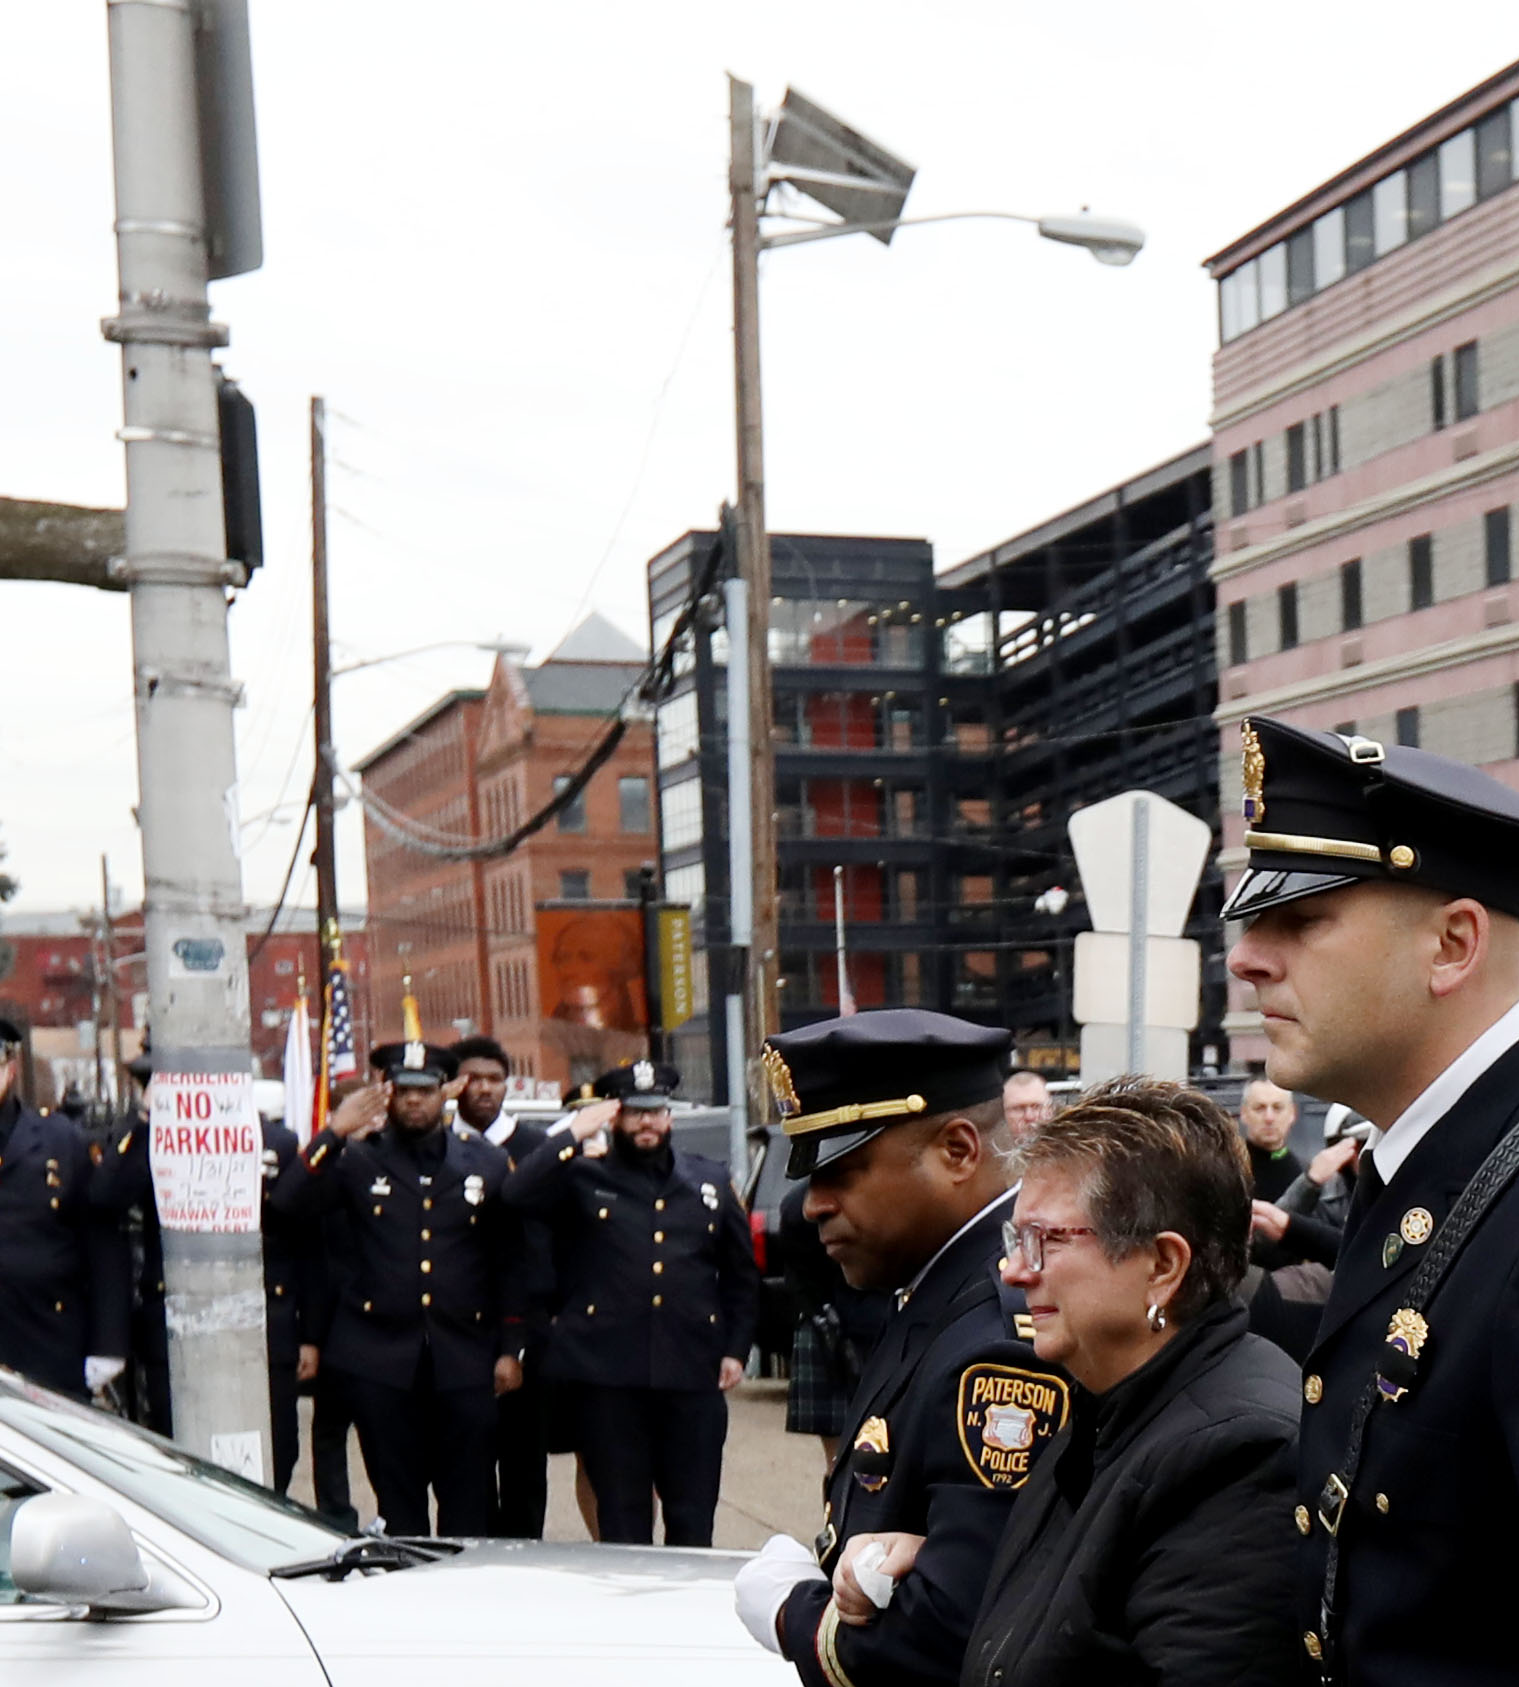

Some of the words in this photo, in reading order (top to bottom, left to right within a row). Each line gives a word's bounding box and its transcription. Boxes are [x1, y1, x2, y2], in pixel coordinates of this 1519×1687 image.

[671, 917, 688, 1014] PATERSON
[176, 1090, 212, 1120] NO
[155, 1126, 254, 1155] PARKING
[224, 1205, 253, 1220] ZONE
[972, 1376, 1056, 1416] PATERSON
[966, 1411, 982, 1427] N.
[1037, 1423, 1052, 1438] J.
[980, 1445, 1030, 1473] POLICE
[992, 1473, 1013, 1484] 1792
